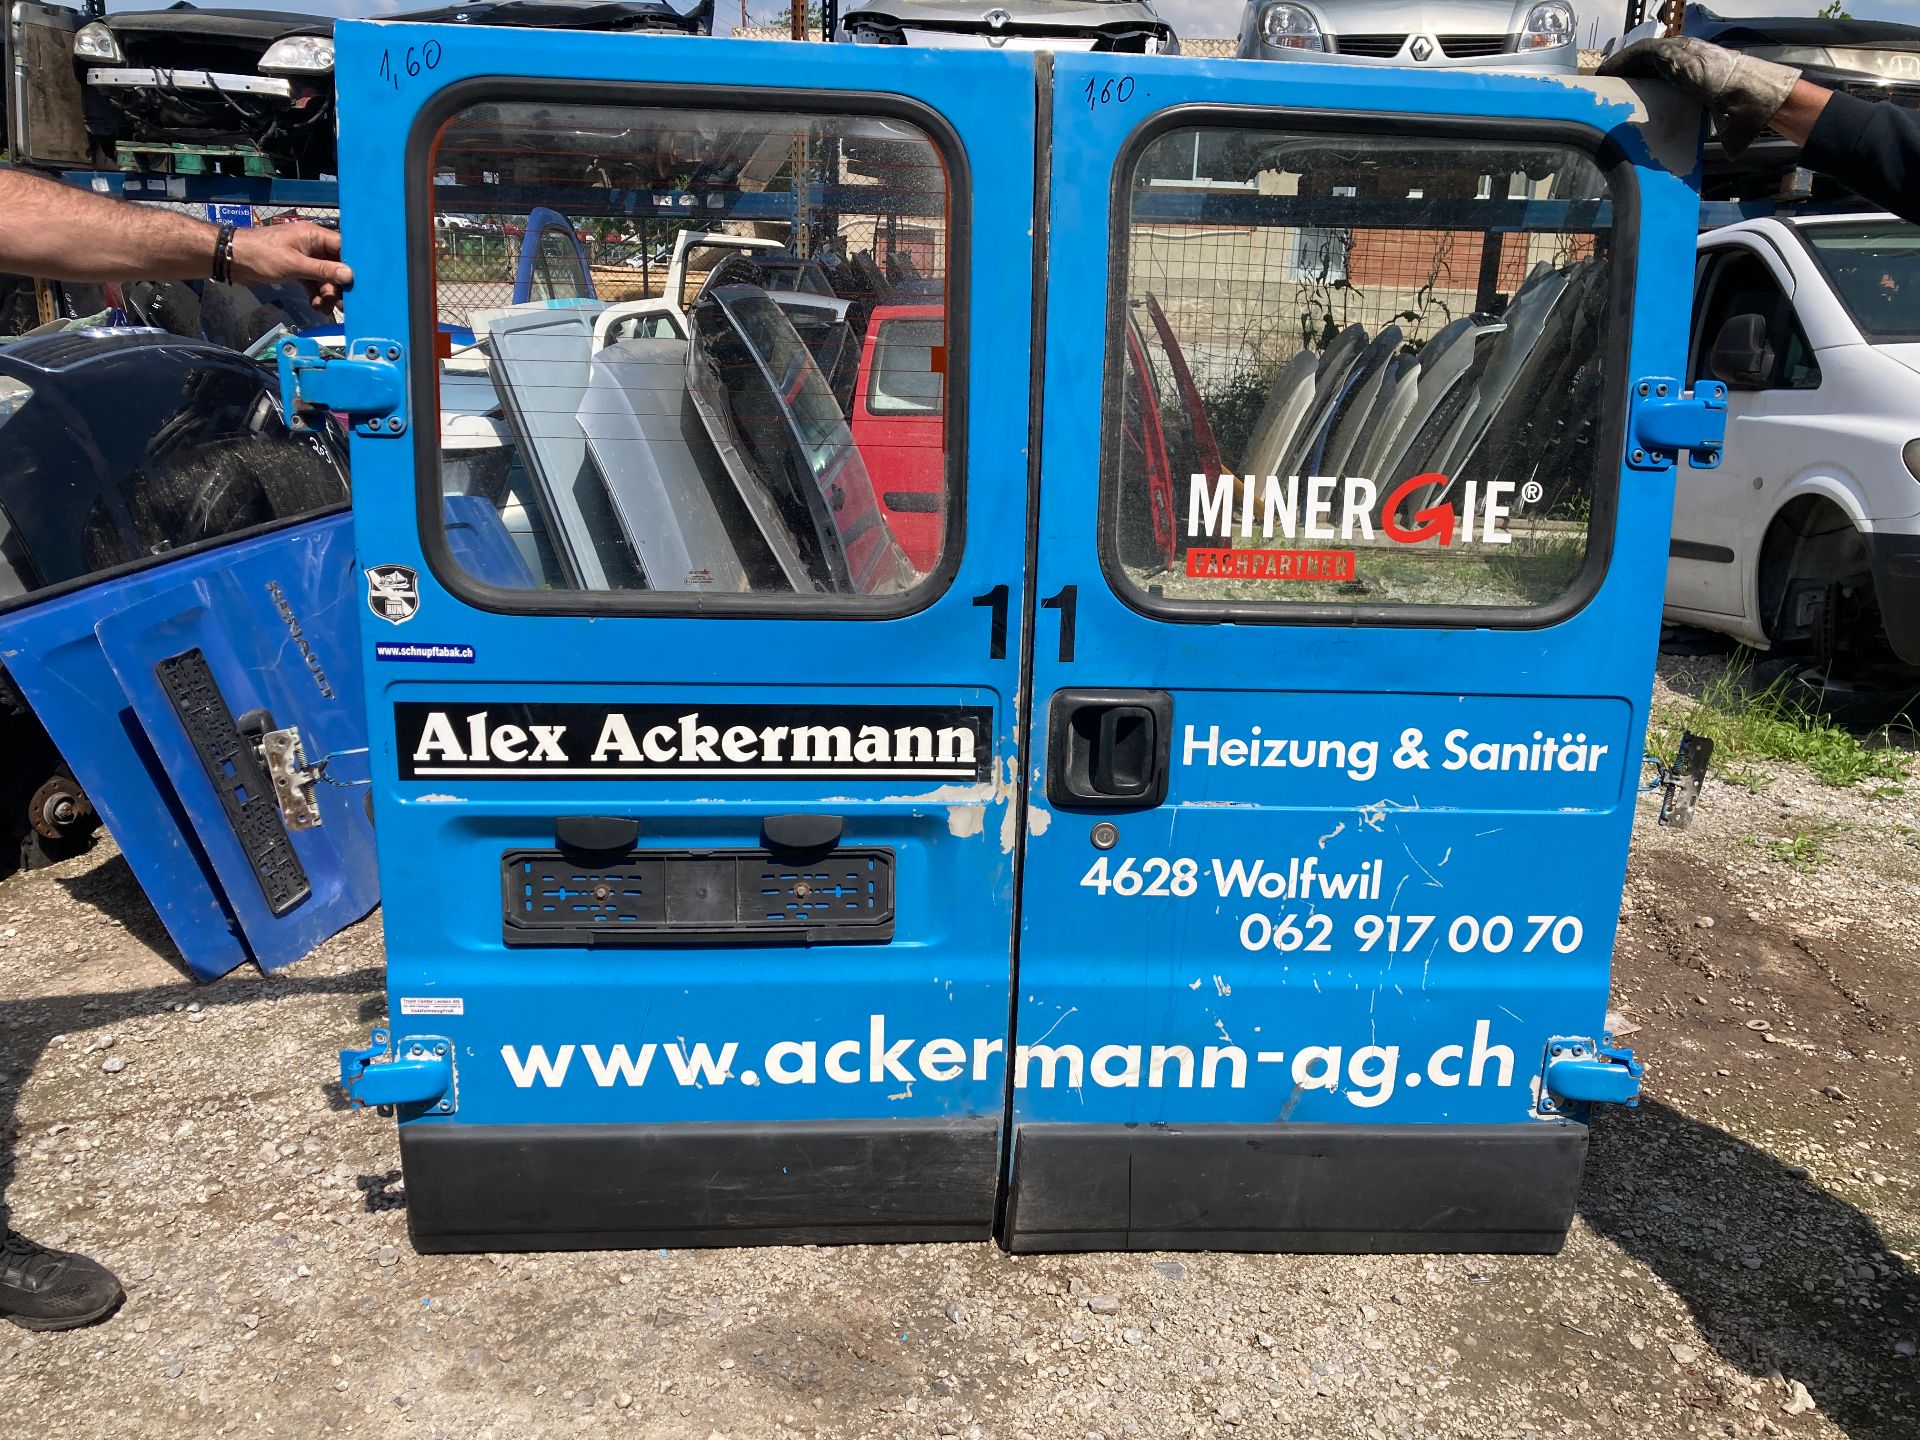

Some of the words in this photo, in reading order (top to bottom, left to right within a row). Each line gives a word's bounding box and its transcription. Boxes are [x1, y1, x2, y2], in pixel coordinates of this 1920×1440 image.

[379, 39, 441, 90] 1,60
[1194, 553, 1348, 577] FACHPARTNER
[377, 646, 474, 659] www.schnupftabak.ch
[413, 711, 569, 762] Alex
[590, 711, 977, 762] Ackermann
[1183, 725, 1379, 781] Heizung
[1392, 727, 1431, 770] &
[1441, 729, 1608, 772] Sanitär
[1080, 857, 1198, 897] 4628
[1211, 856, 1383, 899] Wolfwil
[1240, 913, 1333, 952] 062
[1353, 914, 1437, 952] 917
[1448, 915, 1514, 953] 00
[1523, 915, 1584, 953] 70
[500, 1014, 1514, 1108] www.ackermann-ag.ch
